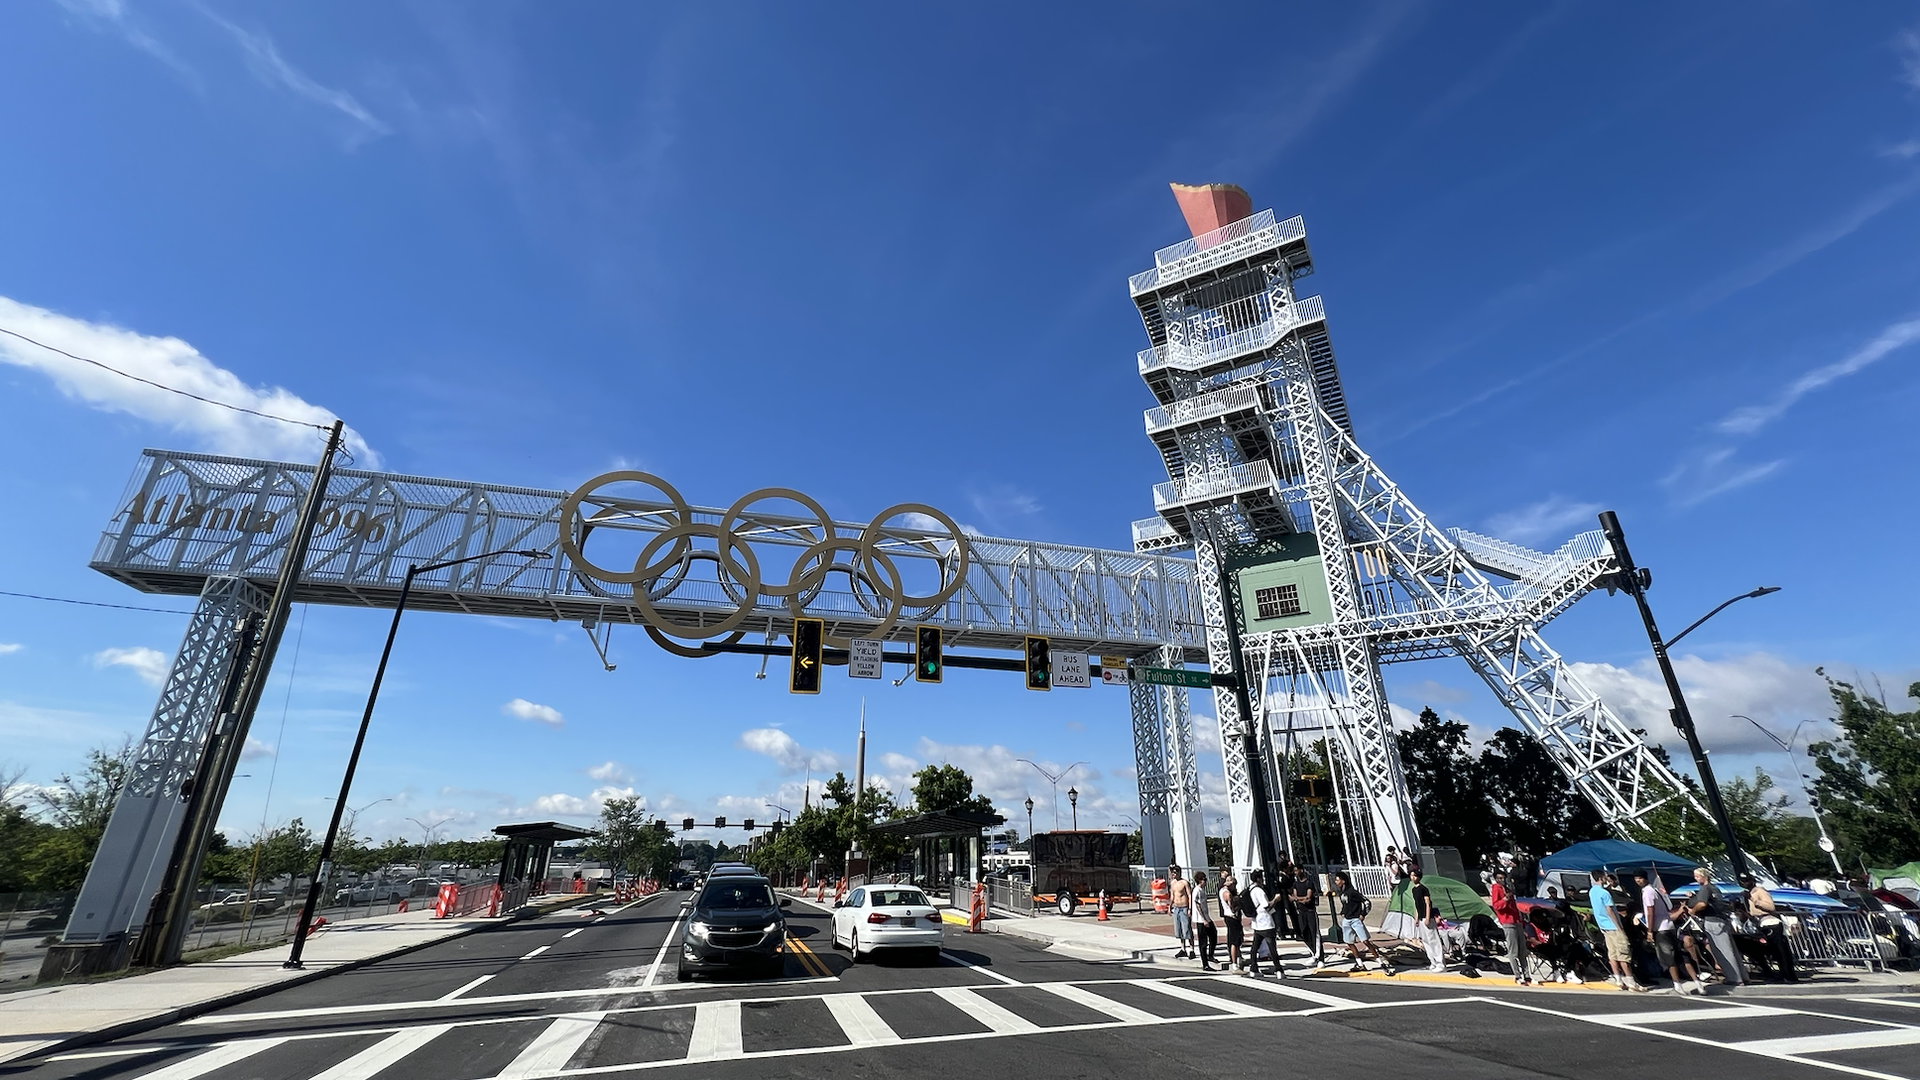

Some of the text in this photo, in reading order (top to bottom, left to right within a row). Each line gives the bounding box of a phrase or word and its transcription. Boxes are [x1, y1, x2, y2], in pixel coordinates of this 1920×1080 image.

[110, 489, 395, 543] Atlanta 996
[856, 647, 877, 656] YIELD
[1063, 655, 1078, 664] BUS
[1061, 665, 1080, 674] LANE
[1059, 675, 1084, 684] AHEAD
[1146, 670, 1173, 682] Fulton
[1176, 672, 1186, 684] St
